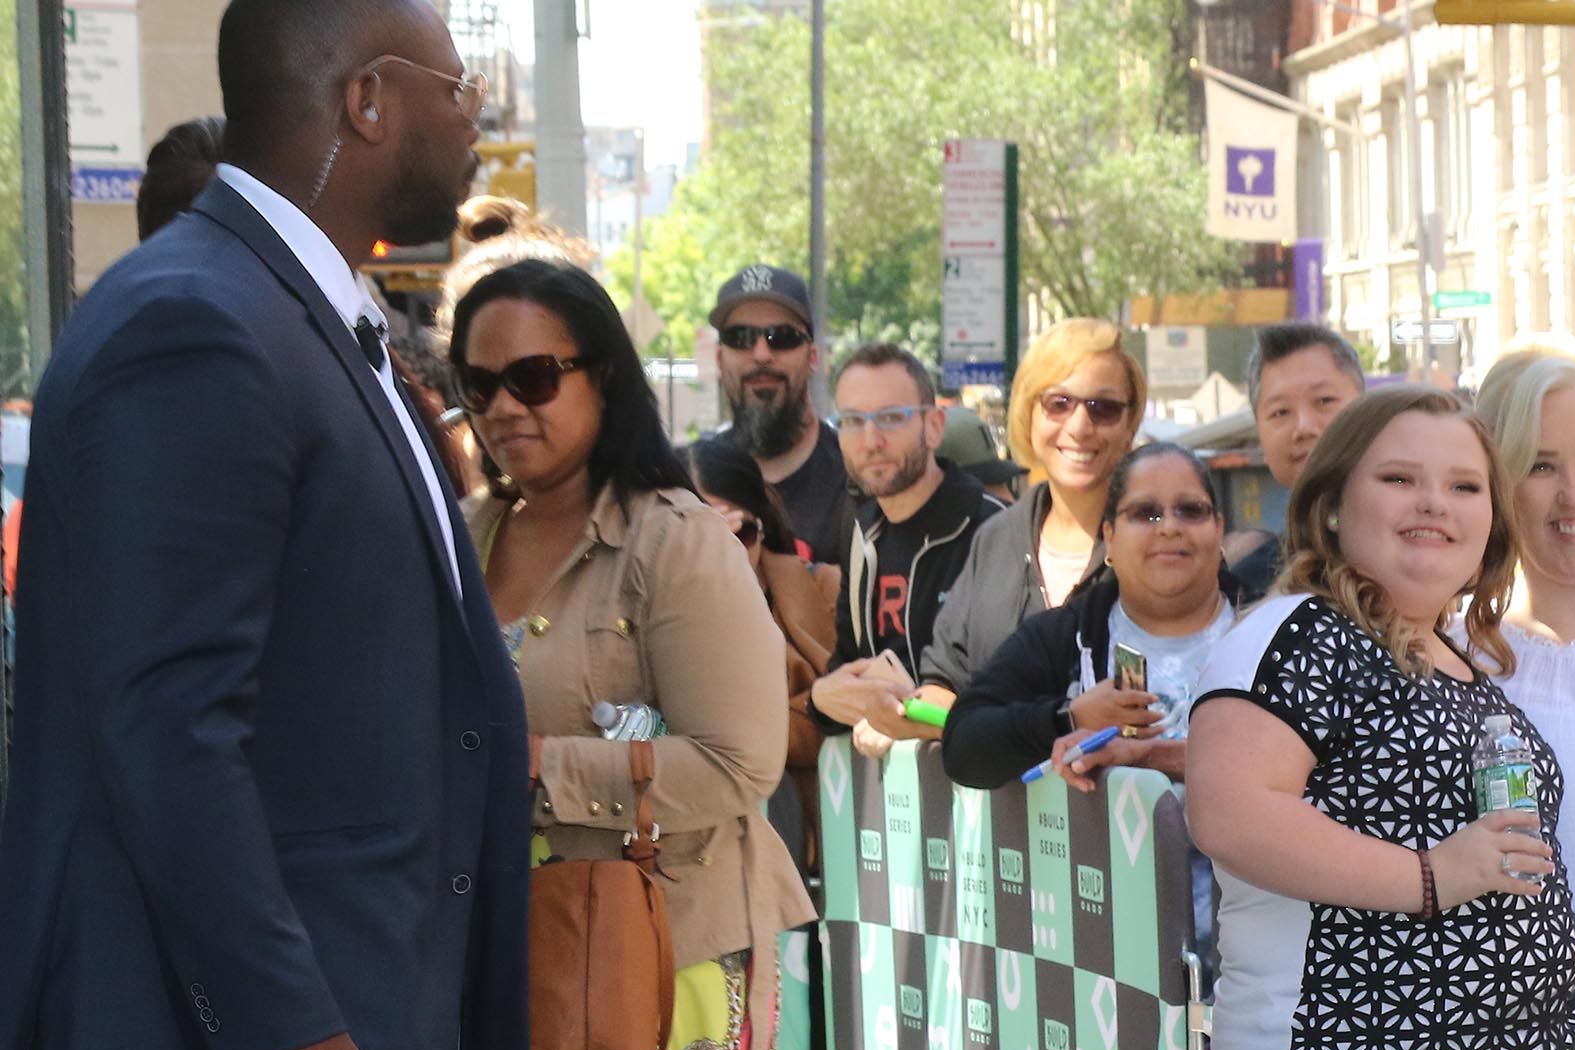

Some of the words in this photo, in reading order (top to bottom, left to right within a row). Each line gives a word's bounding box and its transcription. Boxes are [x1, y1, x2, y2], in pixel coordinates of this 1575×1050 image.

[1225, 201, 1277, 219] NYU
[888, 818, 912, 834] SERIES
[1039, 812, 1065, 831] #BUILD
[1040, 839, 1067, 859] SERIES
[1001, 855, 1021, 878] BUILD
[963, 877, 988, 895] SERIES
[1080, 871, 1102, 897] BUILD
[964, 905, 989, 929] NYC
[1047, 1024, 1068, 1050] BUILD
